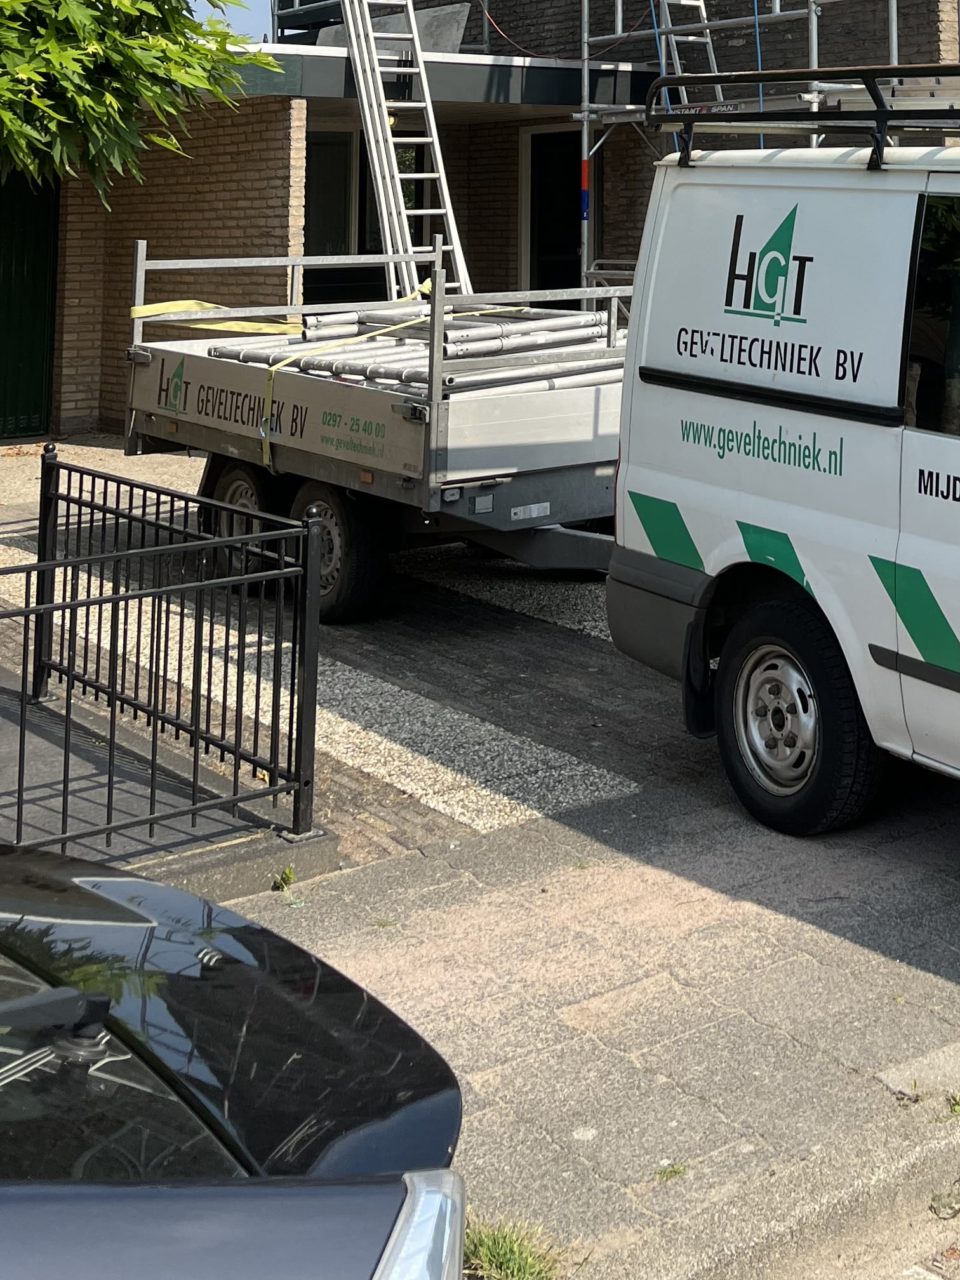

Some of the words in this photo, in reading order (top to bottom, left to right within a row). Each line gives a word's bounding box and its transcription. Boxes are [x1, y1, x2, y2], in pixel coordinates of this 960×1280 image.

[724, 214, 814, 318] HGT
[676, 327, 822, 378] GEVLTECHNIEK
[835, 349, 864, 383] BV
[196, 384, 286, 434] GEVELTECHNEK
[290, 404, 309, 439] BV
[322, 410, 343, 428] 0297
[349, 416, 361, 433] 25
[362, 420, 373, 436] 40
[679, 418, 845, 478] www.geveltechniek.nl
